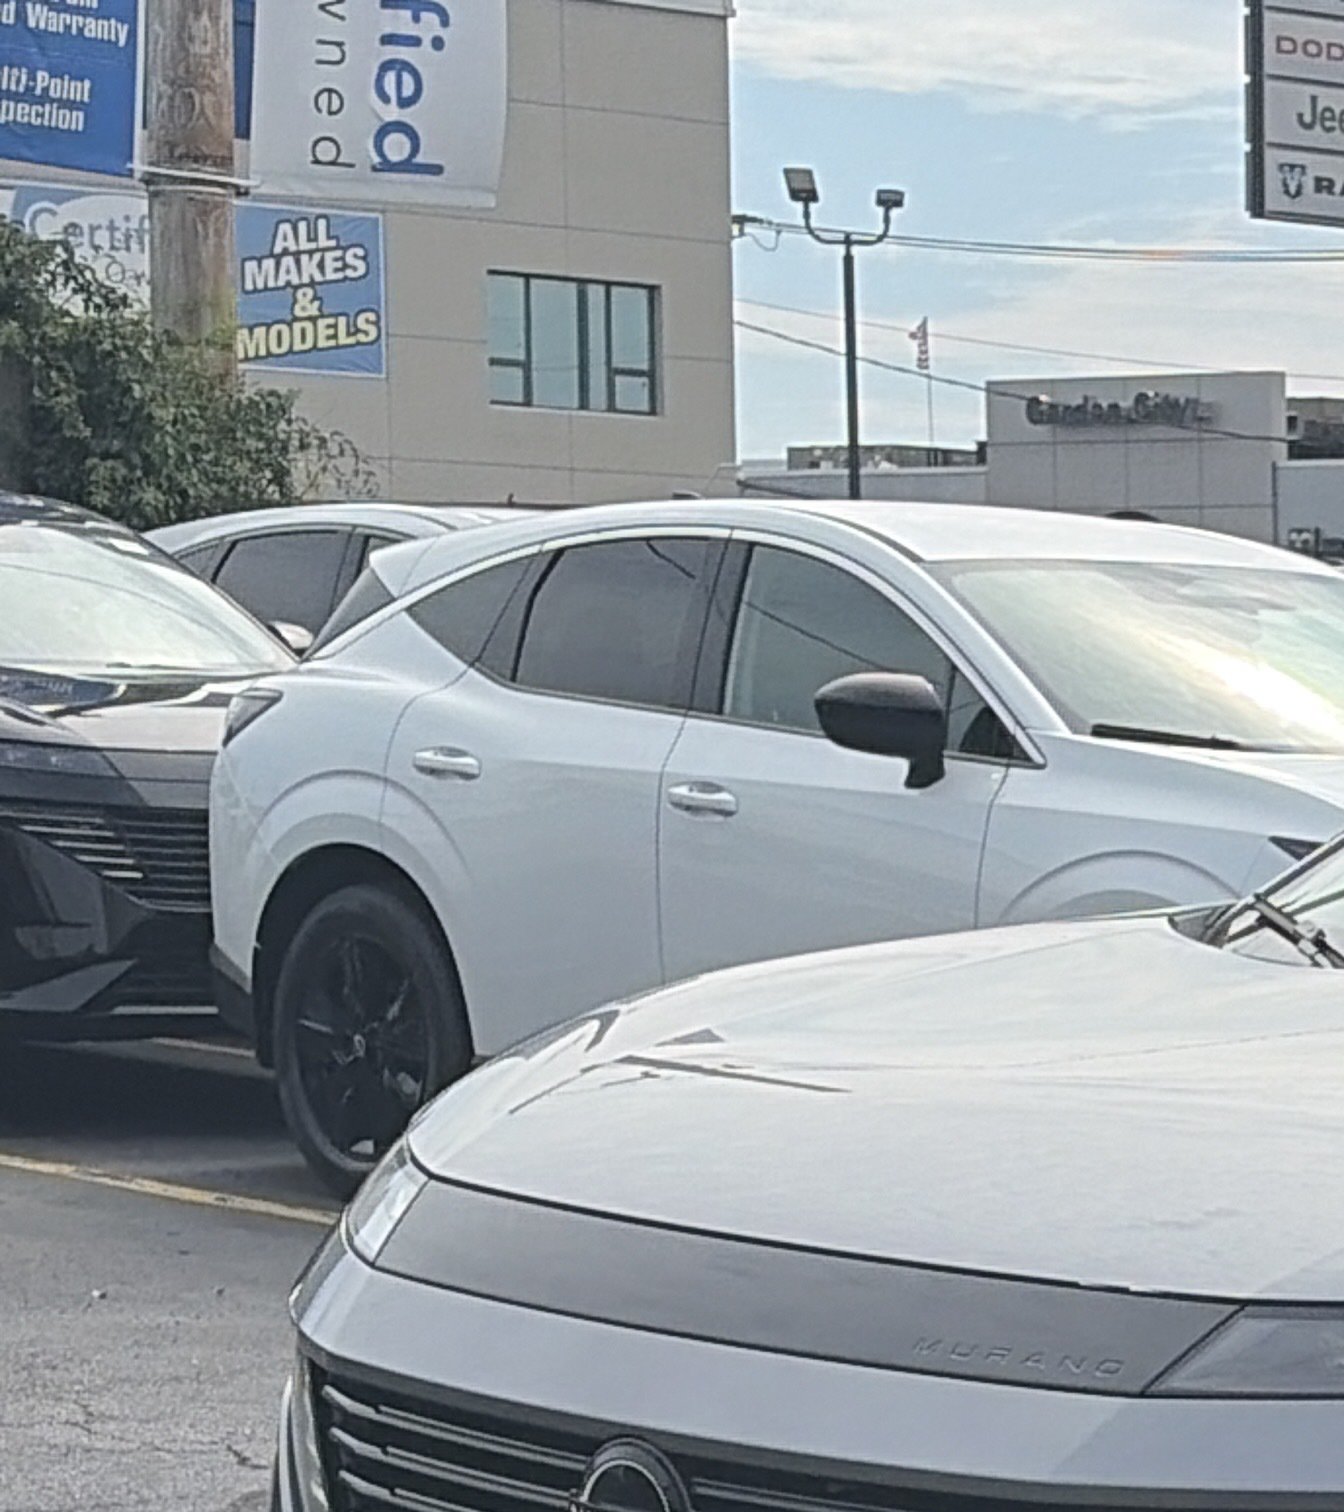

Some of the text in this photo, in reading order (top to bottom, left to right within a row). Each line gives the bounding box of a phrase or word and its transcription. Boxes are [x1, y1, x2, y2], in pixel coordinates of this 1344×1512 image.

[26, 2, 129, 48] Warranty
[370, 0, 450, 177] fied
[0, 99, 85, 132] pection
[272, 214, 339, 256] ALL
[242, 244, 368, 294] MAKES
[291, 285, 323, 320] &
[237, 309, 381, 361] MODELS
[912, 1336, 1126, 1379] MURANO
